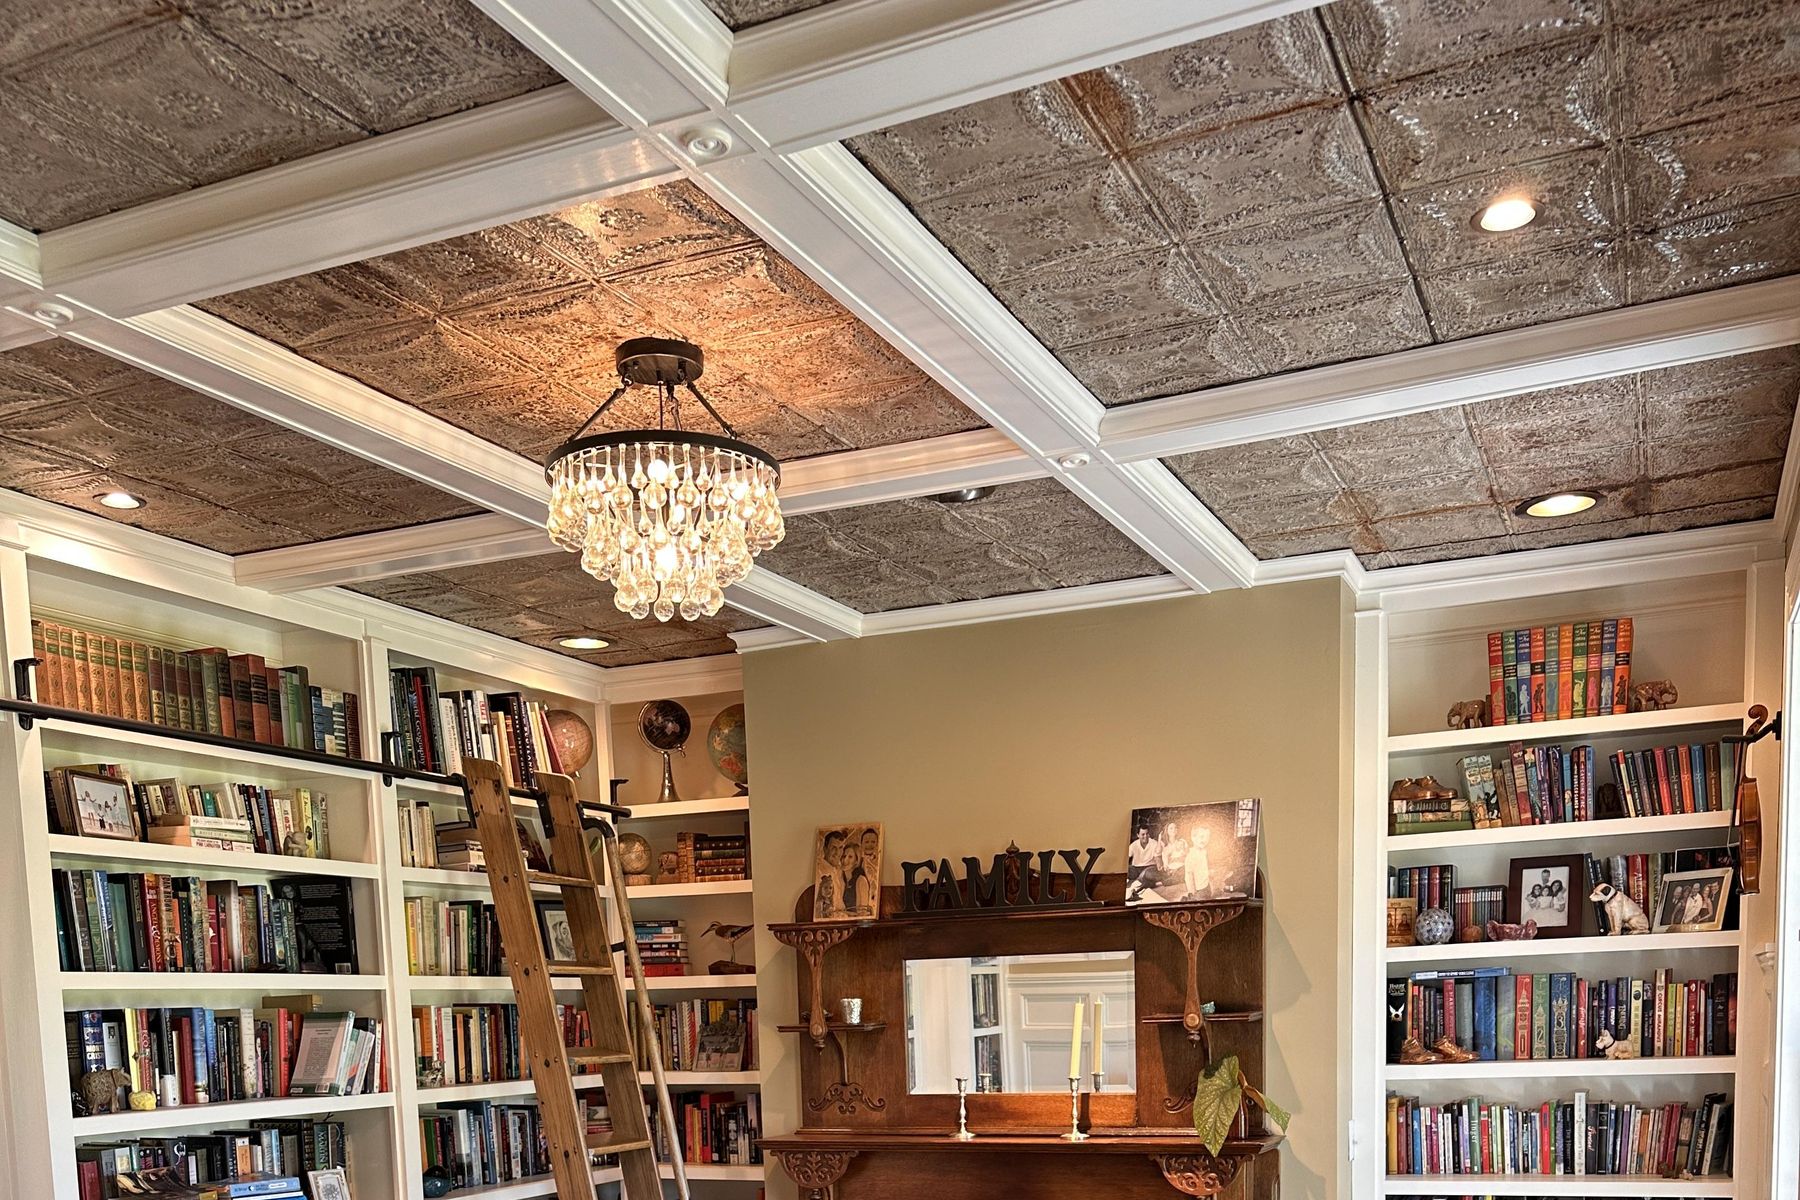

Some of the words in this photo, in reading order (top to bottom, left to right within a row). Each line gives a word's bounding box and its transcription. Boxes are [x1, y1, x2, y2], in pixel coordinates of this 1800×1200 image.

[412, 691, 420, 718] World
[415, 720, 426, 765] Geography
[163, 877, 172, 889] DAN
[901, 848, 1105, 912] FAMILY
[1556, 1016, 1564, 1028] 3
[1470, 1120, 1478, 1144] linger
